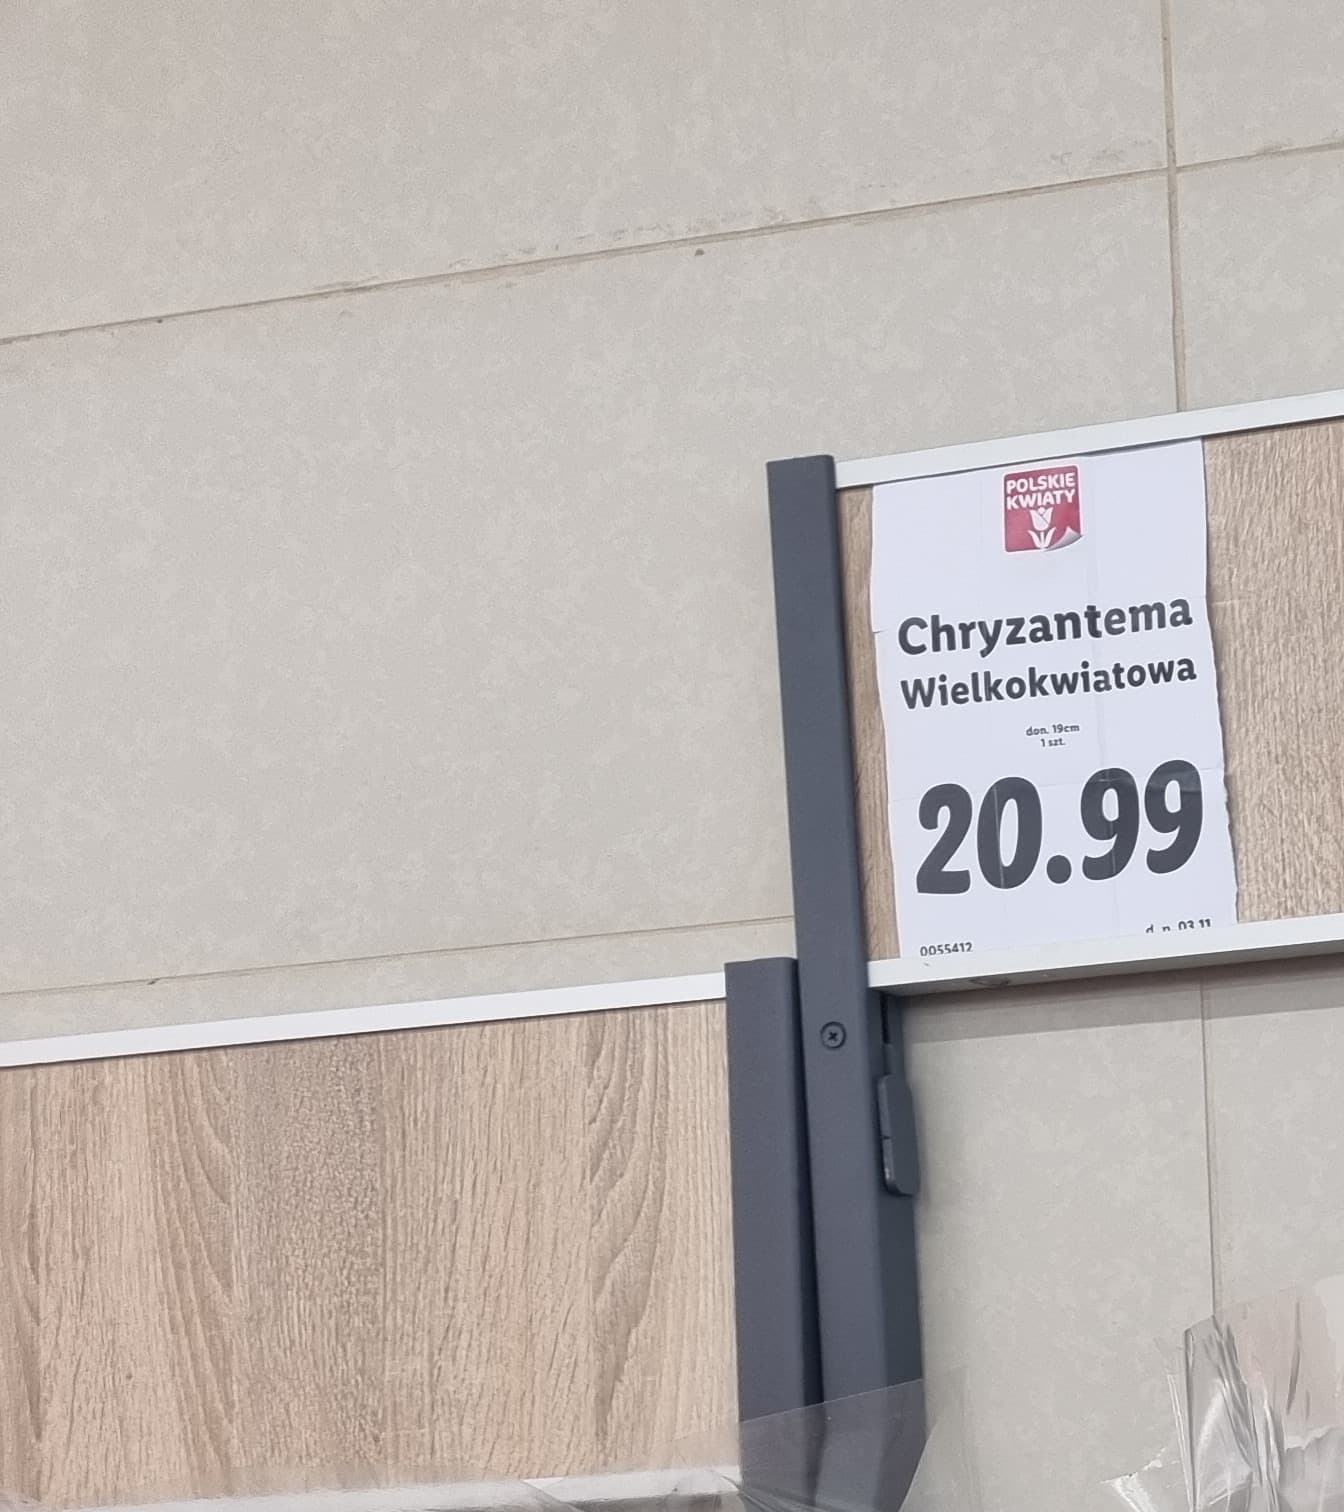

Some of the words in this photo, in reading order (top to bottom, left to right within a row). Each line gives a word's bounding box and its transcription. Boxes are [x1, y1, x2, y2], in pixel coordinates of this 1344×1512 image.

[1006, 472, 1076, 494] POLSKIE
[1006, 489, 1076, 510] KWIATY
[898, 599, 1193, 658] Chryzantema
[900, 657, 1197, 710] Wielkokwiatowa
[916, 759, 1203, 894] 20.99
[919, 941, 973, 957] 0055412
